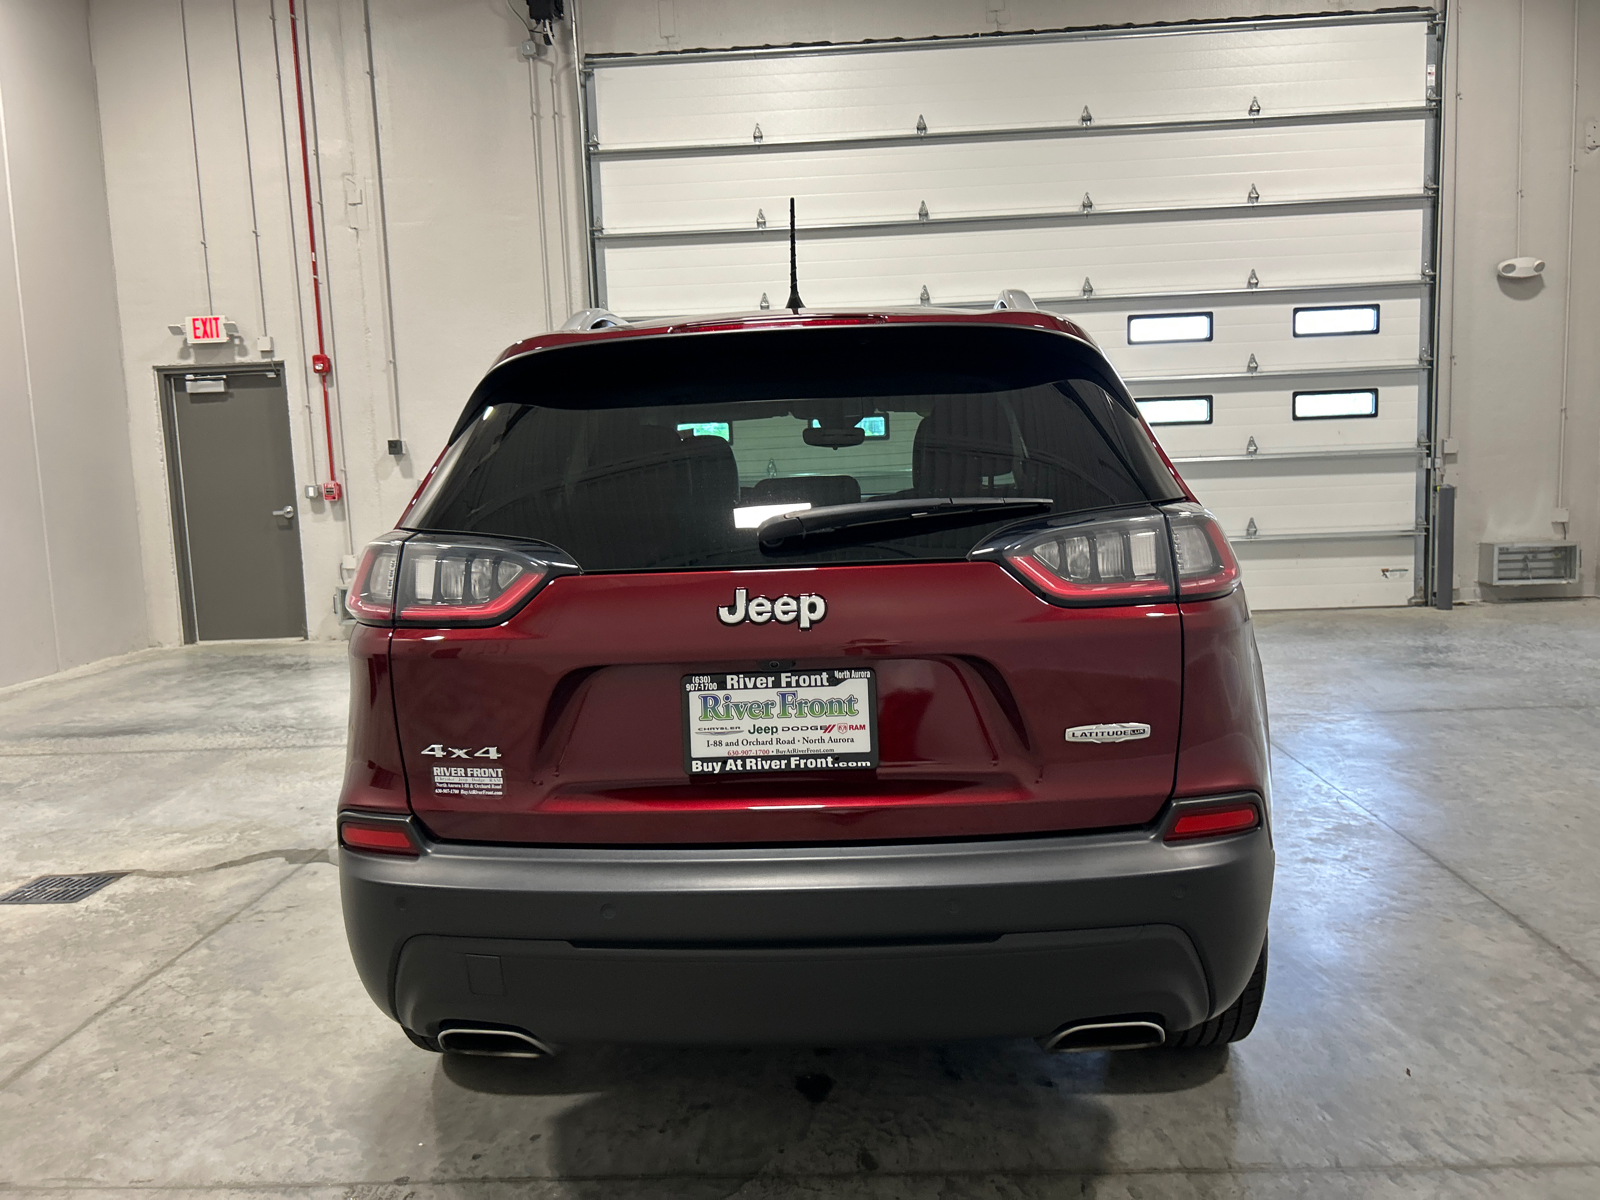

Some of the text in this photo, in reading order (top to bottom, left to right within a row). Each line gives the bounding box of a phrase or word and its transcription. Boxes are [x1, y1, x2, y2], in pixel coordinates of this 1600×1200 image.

[192, 317, 220, 339] EXIT
[717, 588, 828, 631] Jeep
[692, 675, 711, 684] (630)
[834, 669, 871, 679] North Aurora
[685, 682, 718, 691] 907-1700
[726, 672, 829, 690] River Front
[748, 724, 779, 735] Jeep
[1071, 730, 1130, 738] LATITUDE
[706, 736, 855, 748] I-88 and Orchard Road North Aurora
[420, 744, 502, 760] 4x4
[692, 756, 871, 773] Buy At River Front.com
[433, 767, 503, 778] RIVER FRONT
